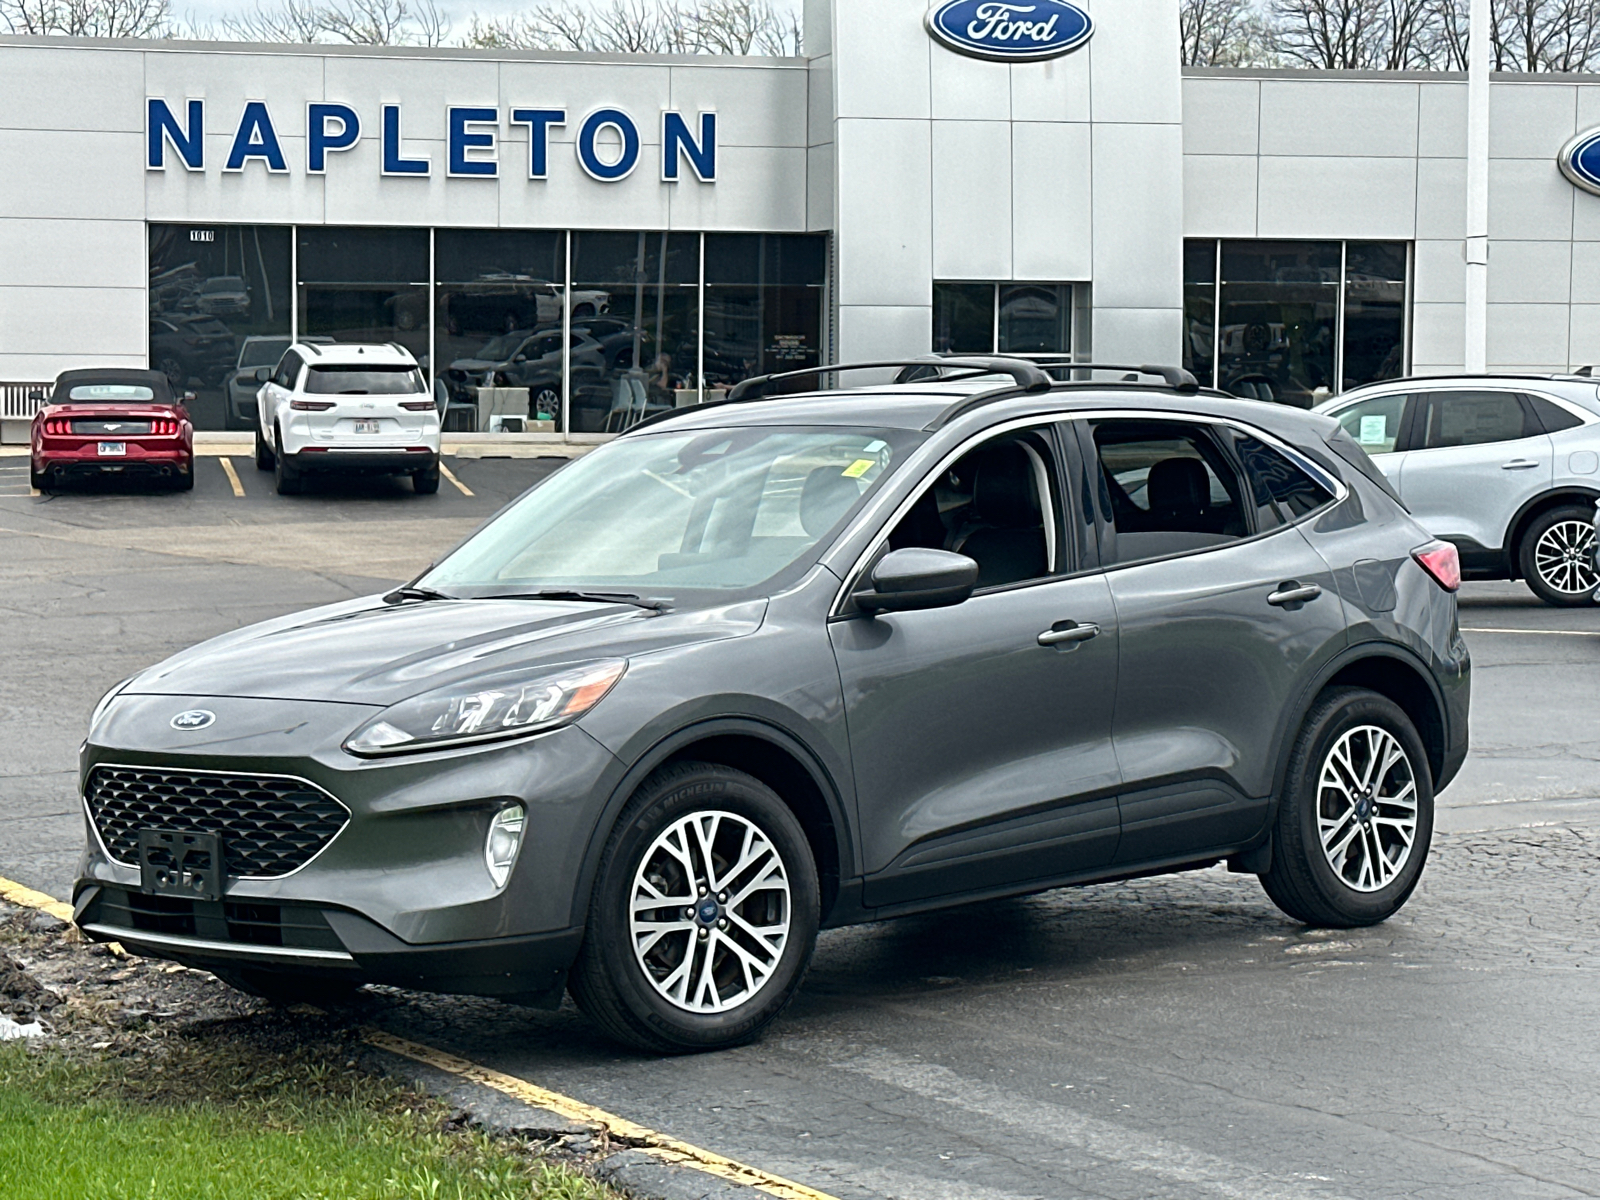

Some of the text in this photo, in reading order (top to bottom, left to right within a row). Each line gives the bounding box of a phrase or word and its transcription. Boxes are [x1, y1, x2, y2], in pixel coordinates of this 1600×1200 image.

[967, 2, 1059, 42] Ford
[145, 98, 717, 183] NAPLETON
[190, 230, 214, 242] 1010
[663, 782, 724, 810] MICHELIN
